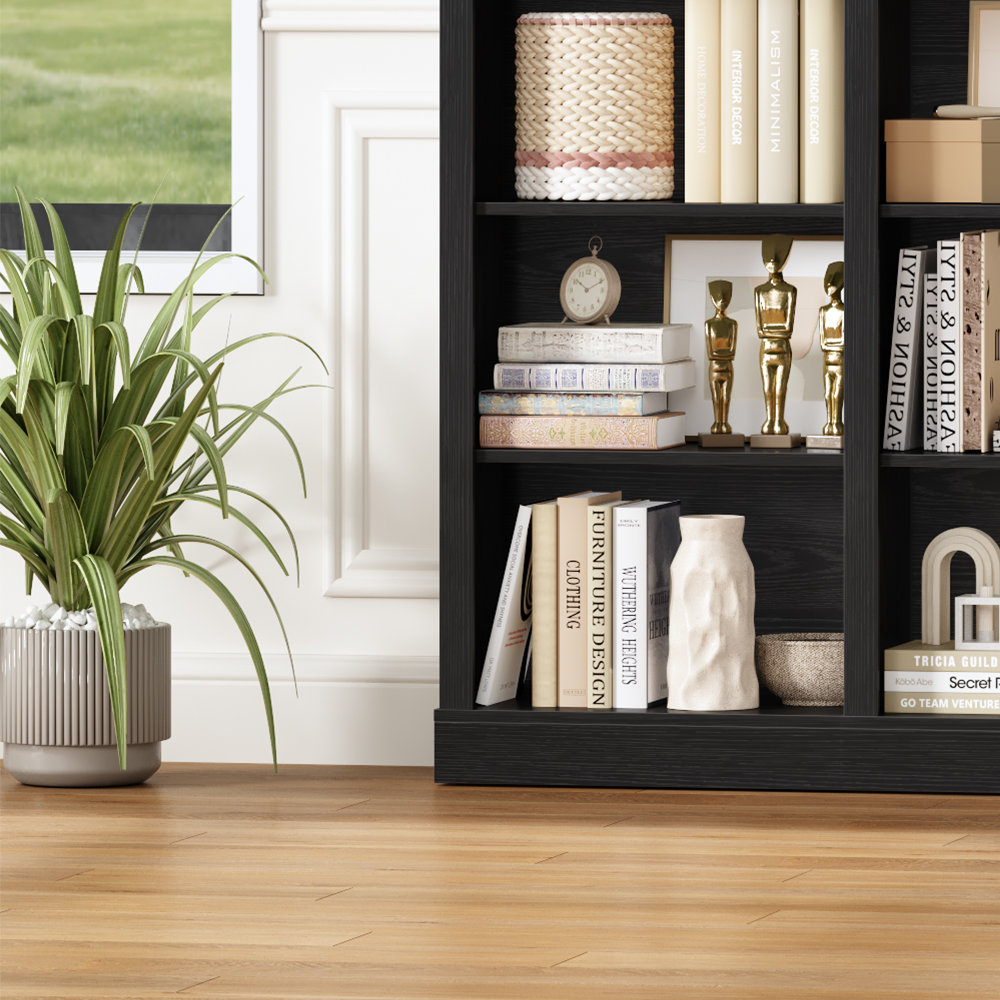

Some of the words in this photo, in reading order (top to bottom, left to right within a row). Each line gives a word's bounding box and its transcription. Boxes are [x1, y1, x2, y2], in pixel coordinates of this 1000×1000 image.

[731, 50, 743, 104] INTERIOR
[770, 30, 781, 153] MINIMALISM
[809, 48, 820, 103] INTERIOR
[731, 107, 743, 146] DECOR
[809, 106, 820, 145] DECOR
[566, 560, 581, 630] CLOTHING
[592, 510, 606, 627] FURNITURE
[621, 565, 637, 634] WUTHERING
[592, 633, 606, 706] DESIGN
[621, 639, 637, 686] HEIGHTS
[914, 655, 956, 667] TRICIA
[961, 656, 998, 668] GUILD
[949, 676, 992, 689] Secret
[900, 698, 917, 708] GO
[919, 698, 949, 709] TEAM
[951, 699, 1000, 710] VENTURE
